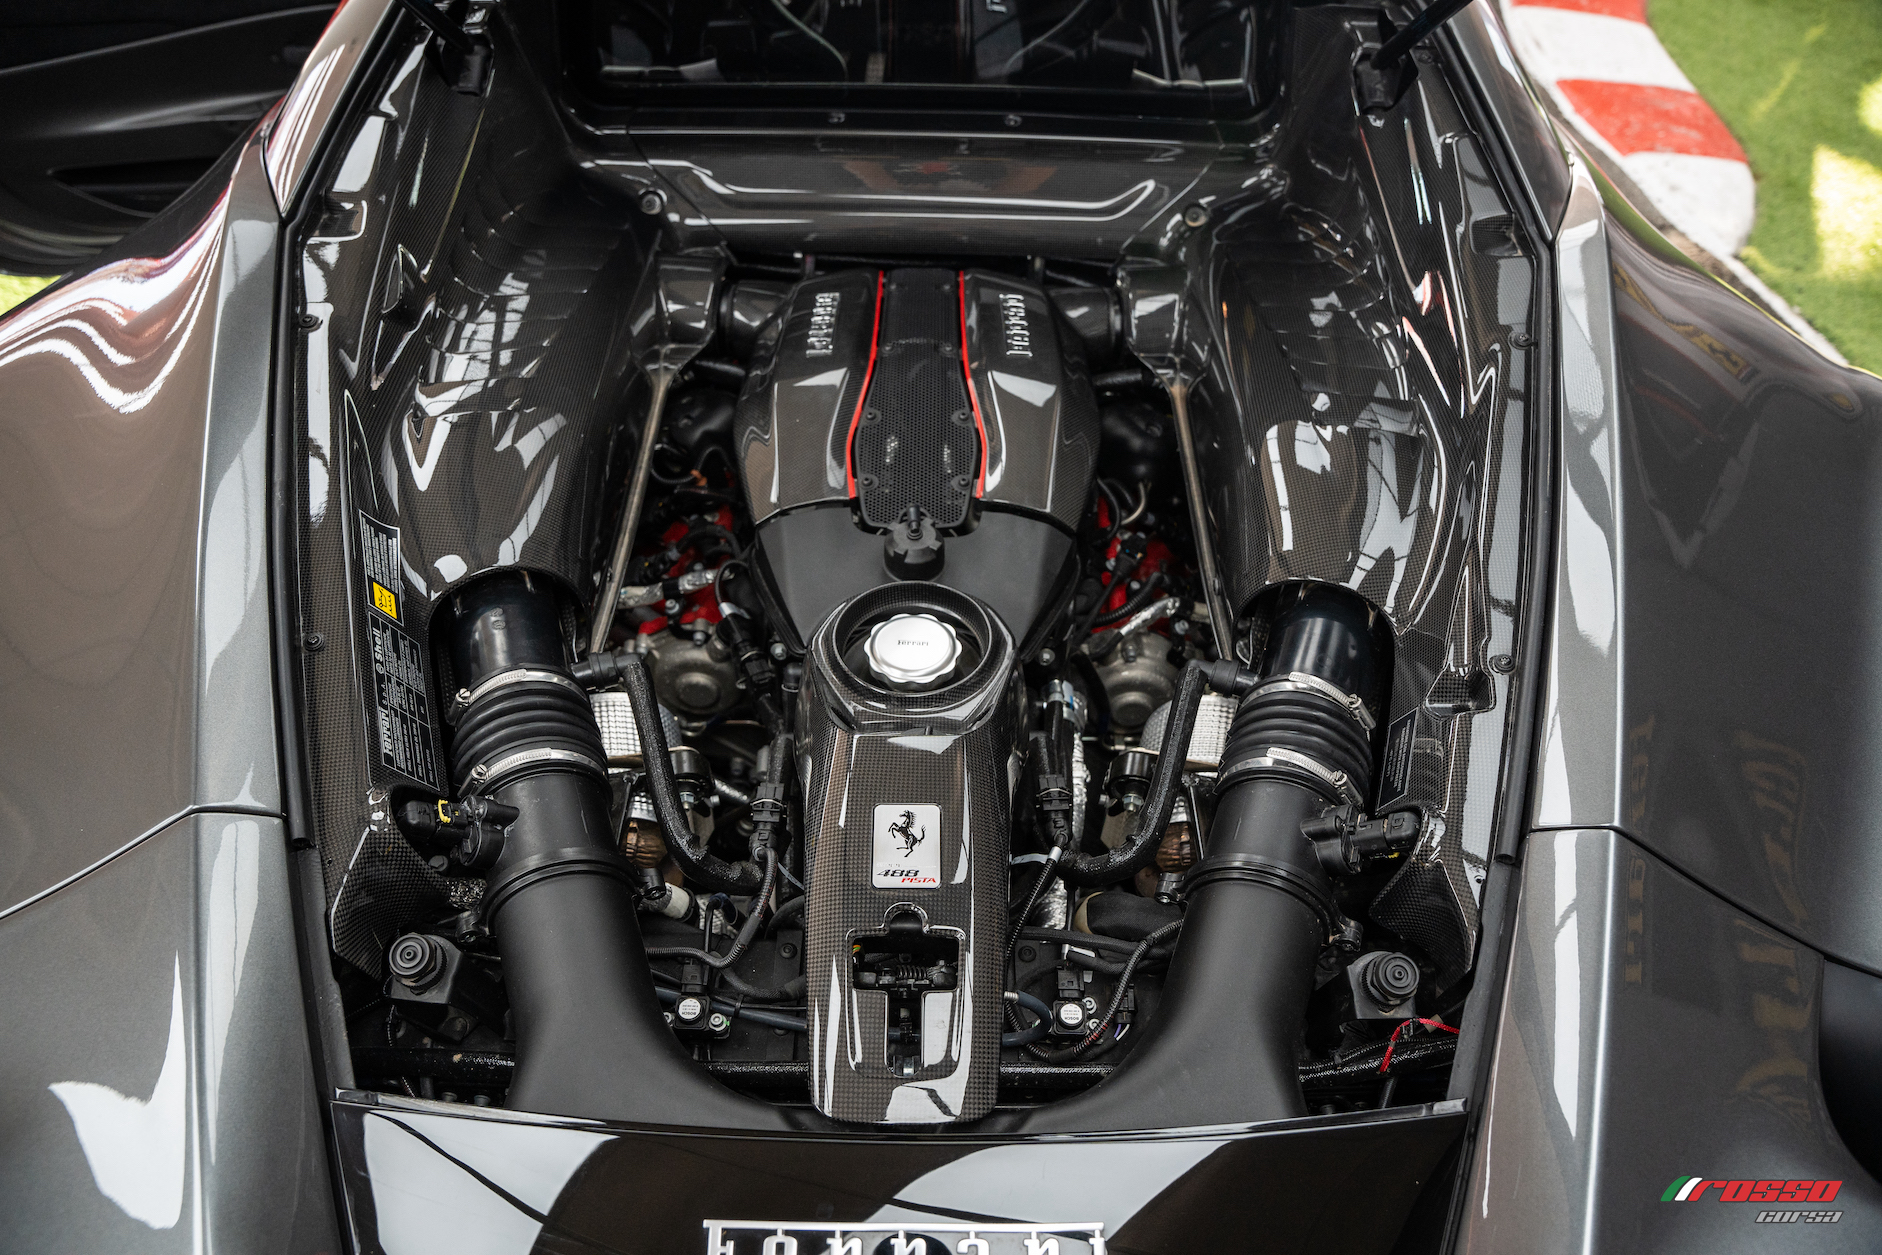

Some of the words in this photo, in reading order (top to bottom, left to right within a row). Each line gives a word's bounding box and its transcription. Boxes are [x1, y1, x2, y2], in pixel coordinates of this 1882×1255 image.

[372, 627, 383, 662] Shell
[379, 705, 394, 757] Ferrari
[877, 869, 919, 877] 488
